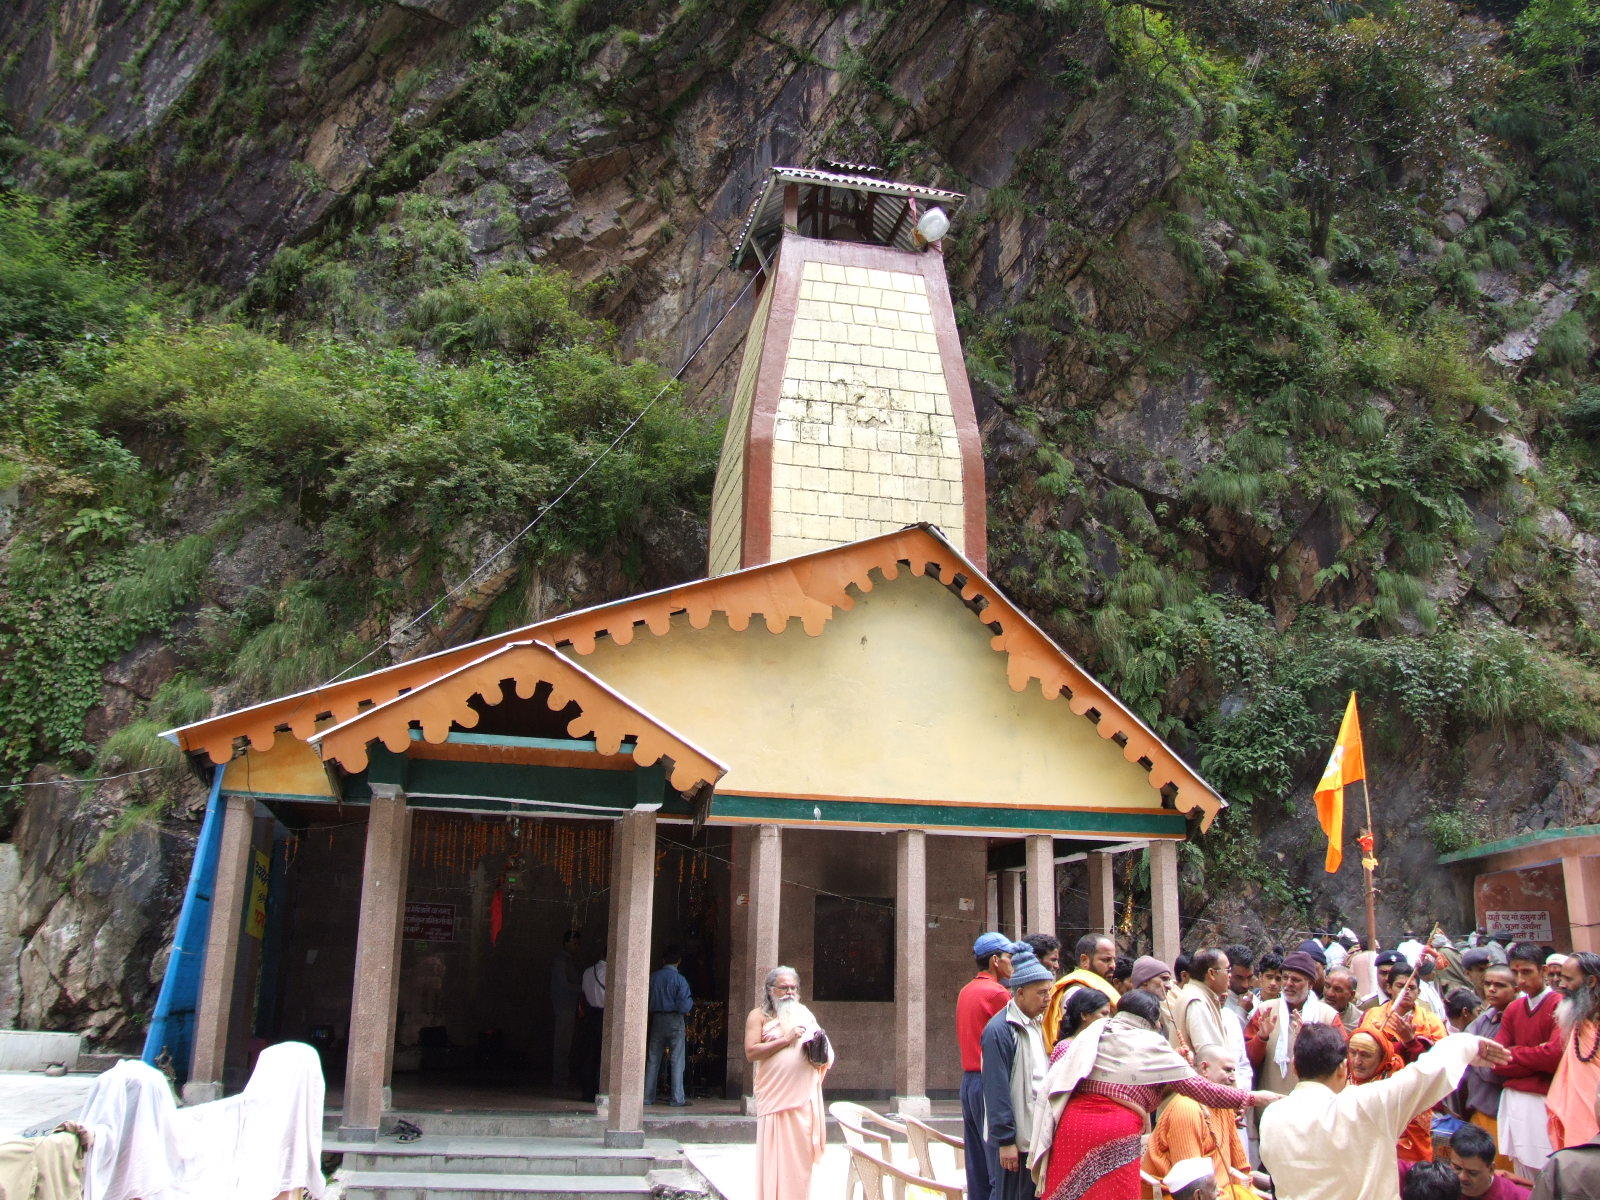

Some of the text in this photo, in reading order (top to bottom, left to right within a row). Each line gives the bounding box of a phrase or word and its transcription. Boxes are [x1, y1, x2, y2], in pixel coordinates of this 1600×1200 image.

[1519, 914, 1536, 922] यमुना
[1537, 912, 1547, 920] जी
[1492, 922, 1502, 930] की
